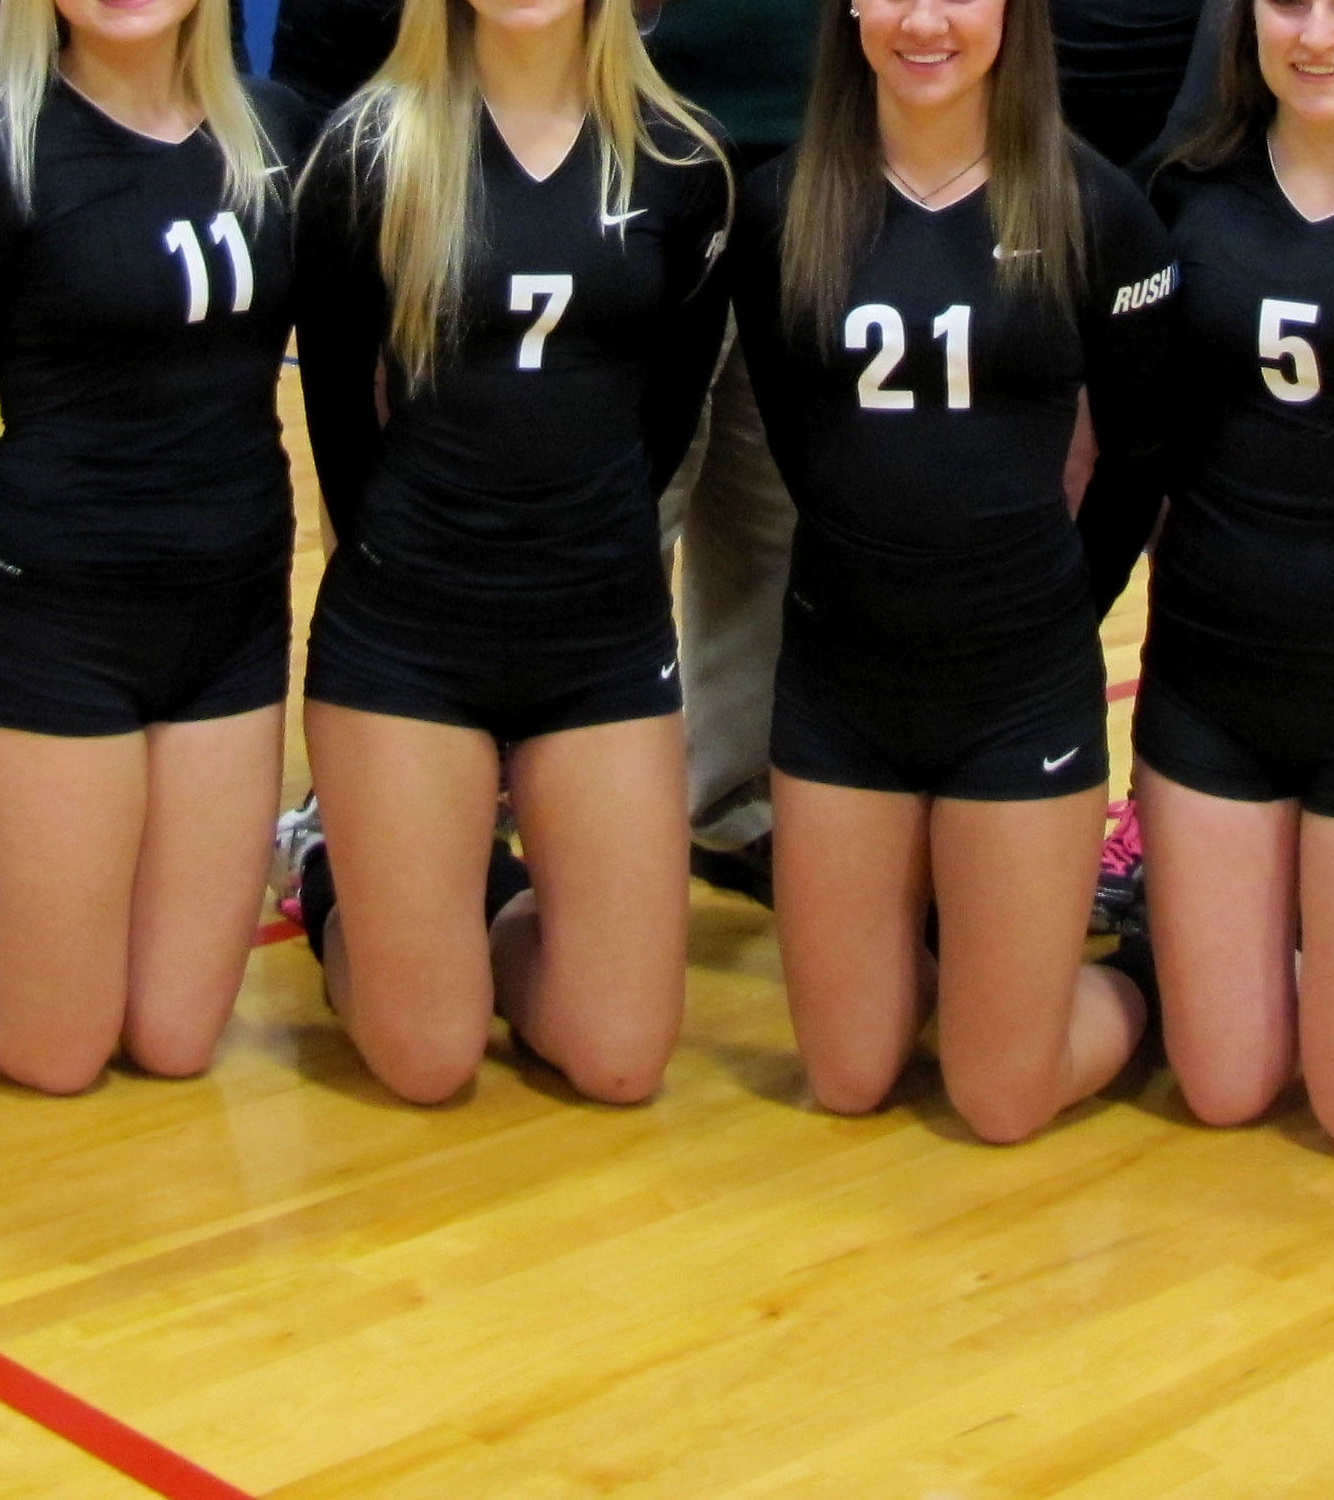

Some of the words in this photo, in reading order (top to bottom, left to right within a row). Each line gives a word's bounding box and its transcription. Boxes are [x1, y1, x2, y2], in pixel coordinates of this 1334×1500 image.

[165, 211, 254, 323] 11
[1112, 266, 1171, 315] RUSH
[510, 274, 573, 369] 7
[845, 303, 971, 409] 21
[1258, 299, 1321, 402] 5
